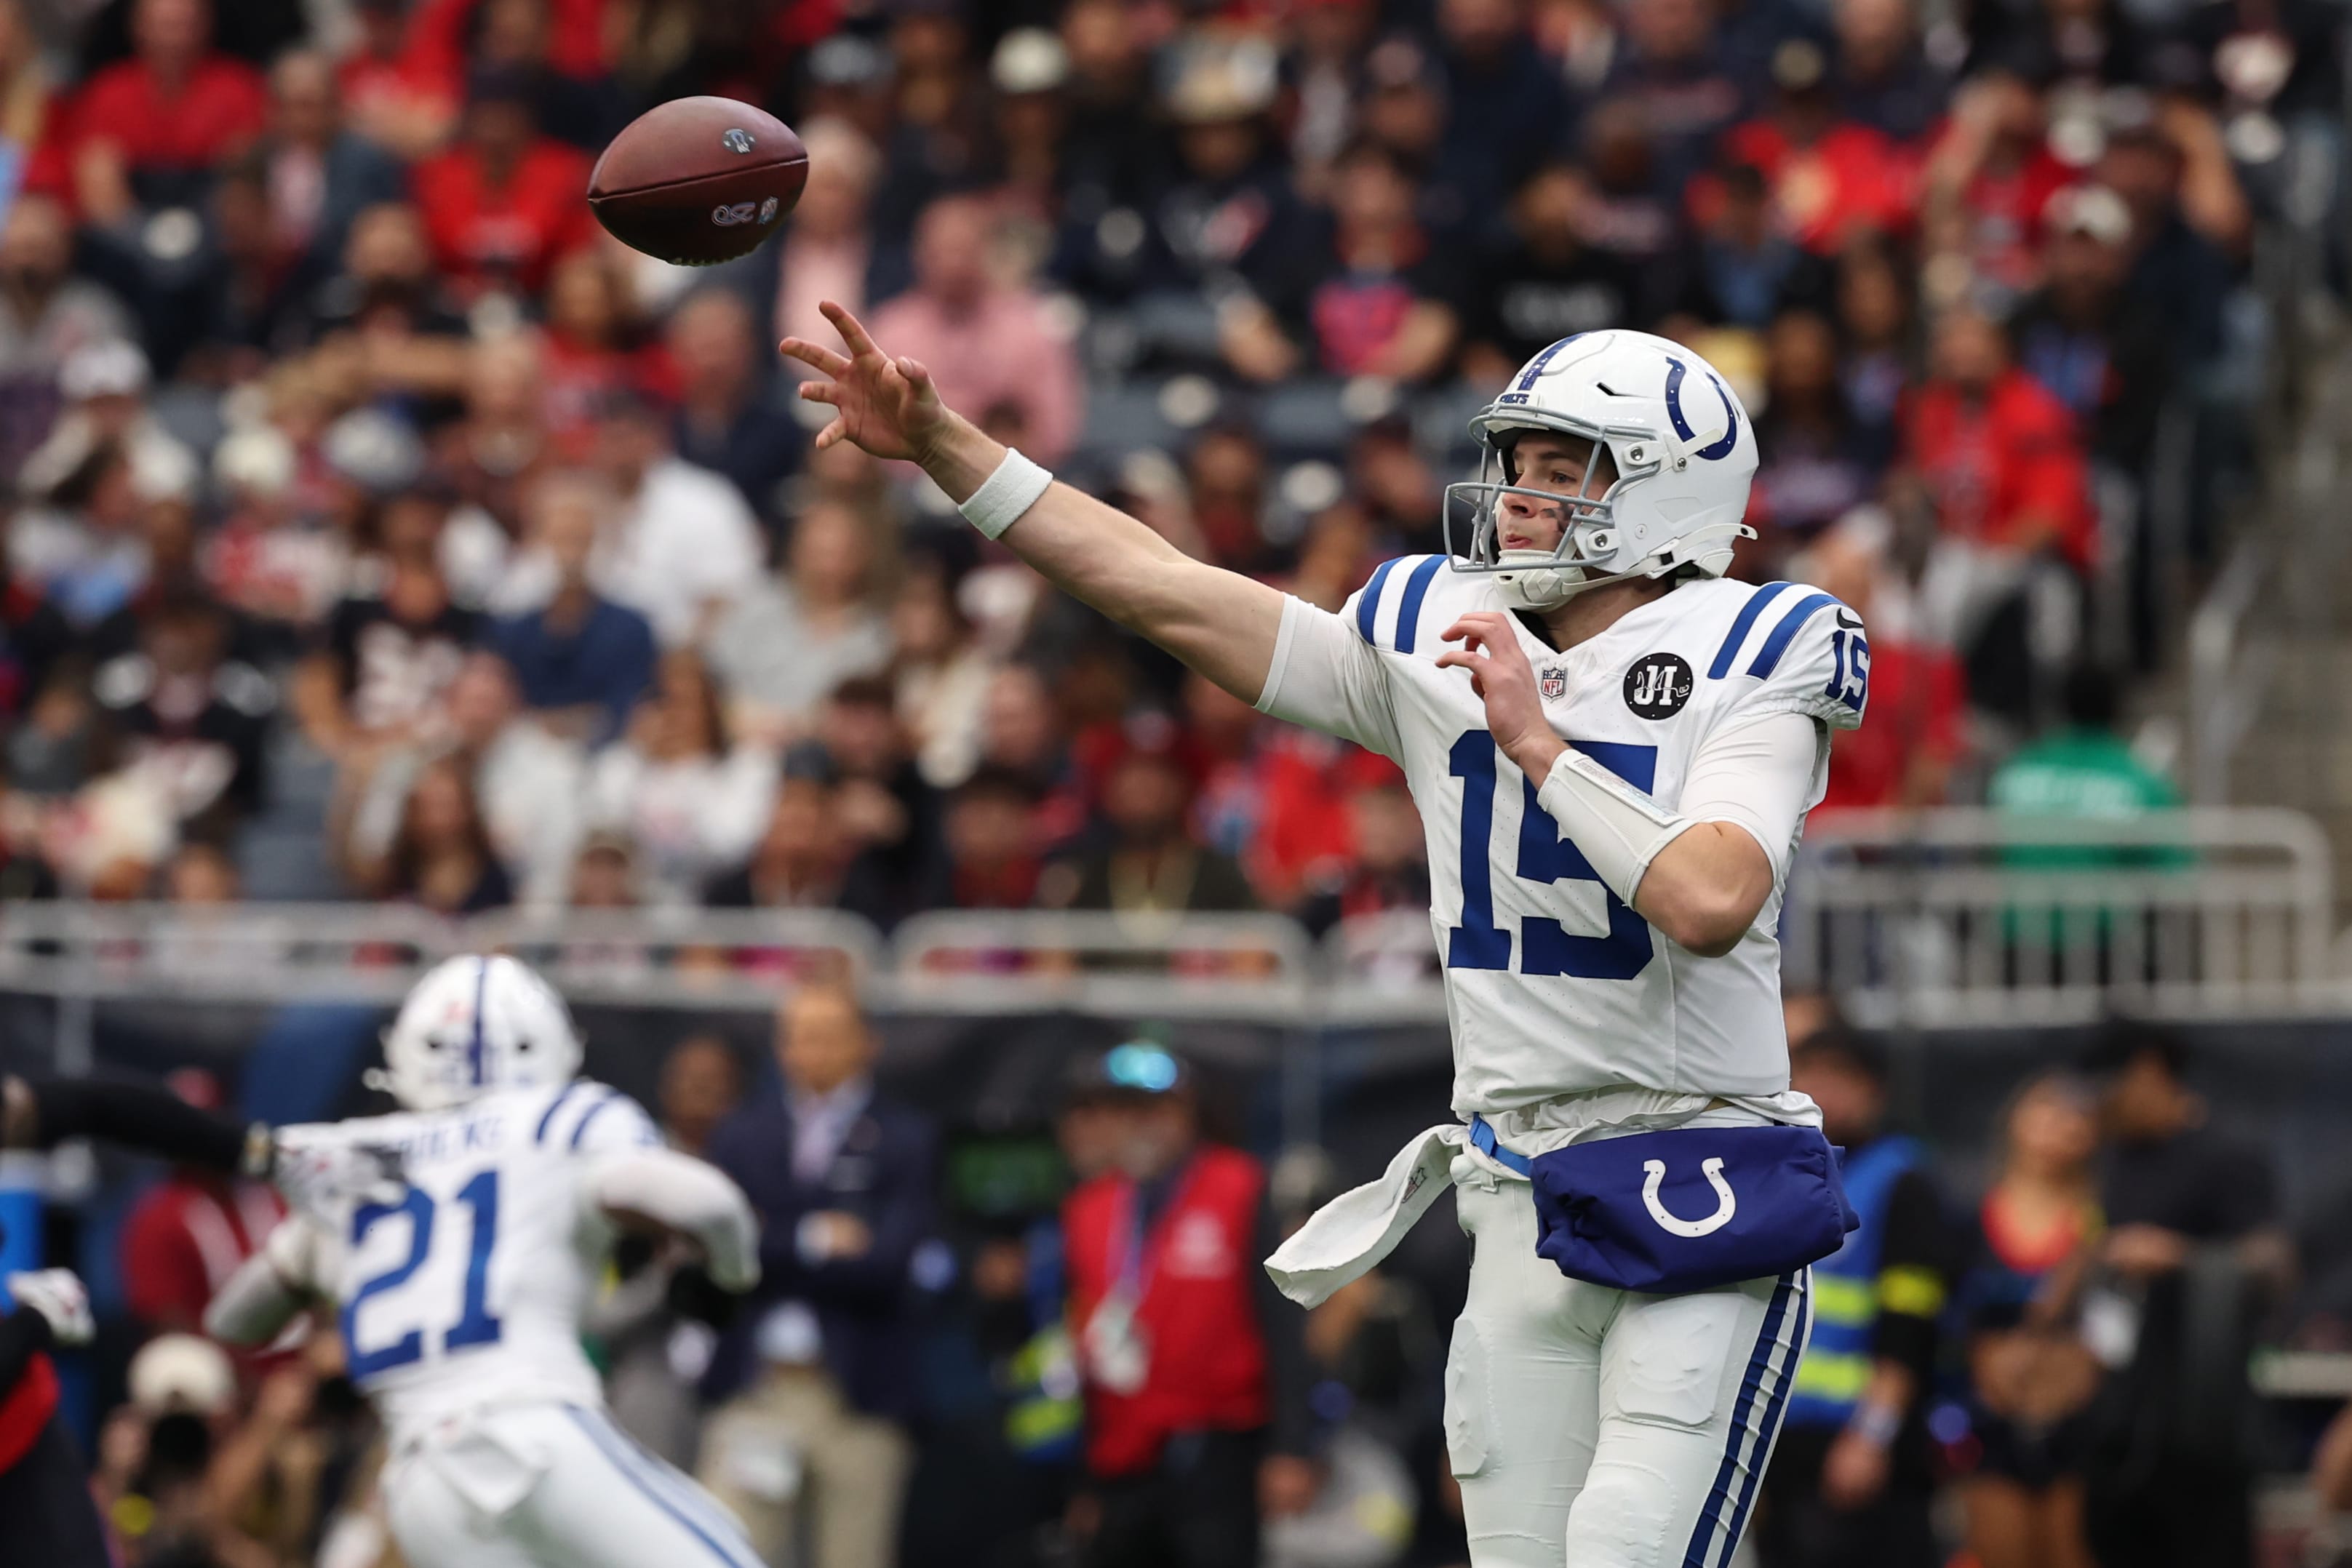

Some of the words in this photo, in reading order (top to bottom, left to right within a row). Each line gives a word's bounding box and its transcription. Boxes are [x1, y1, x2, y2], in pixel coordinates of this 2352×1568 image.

[1544, 680, 1563, 695] NFL
[1825, 629, 1870, 711] 15
[1448, 729, 1659, 980] 15
[340, 1169, 502, 1386] 21
